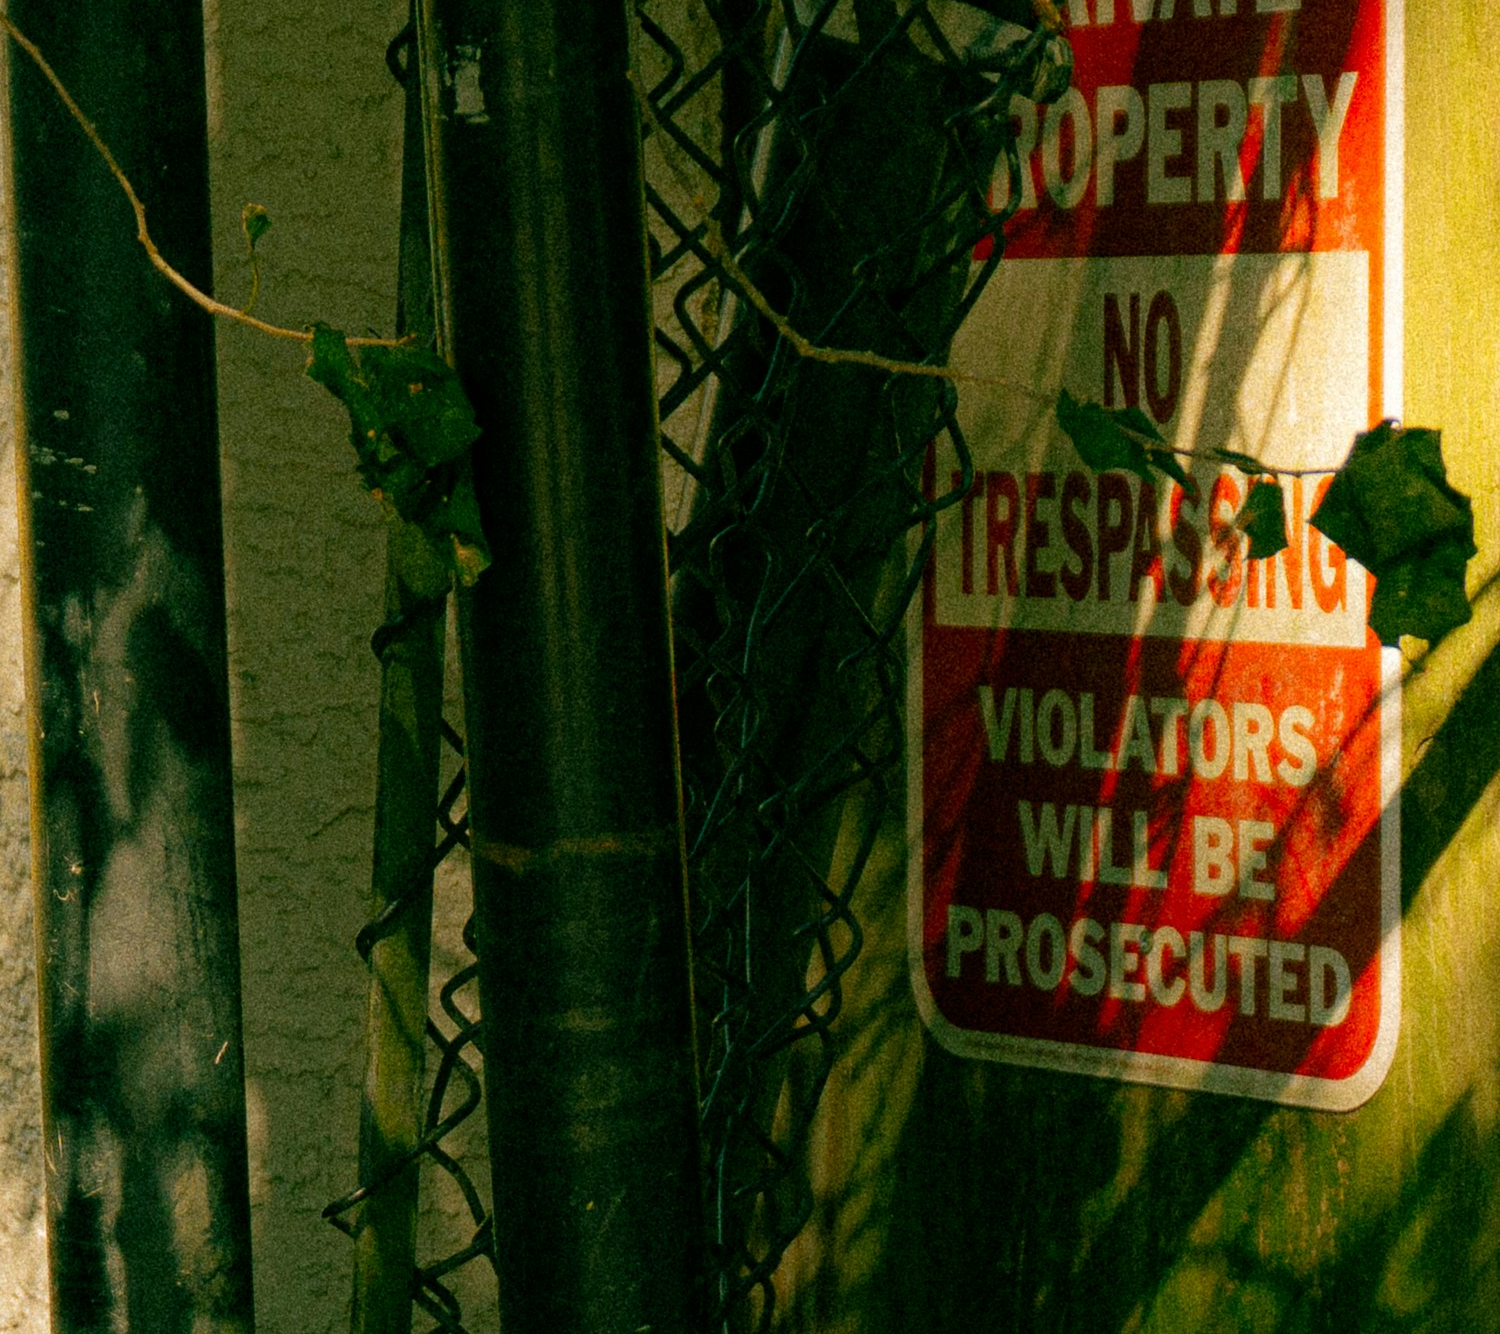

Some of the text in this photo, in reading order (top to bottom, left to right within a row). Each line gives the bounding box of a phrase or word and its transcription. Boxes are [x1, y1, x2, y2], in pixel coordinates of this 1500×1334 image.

[991, 71, 1358, 211] ROPERTY
[1103, 290, 1182, 425] NO
[978, 685, 1318, 787] VIOLATORS
[1018, 800, 1276, 901] WILL BE
[945, 904, 1352, 1028] PROSECUTED
